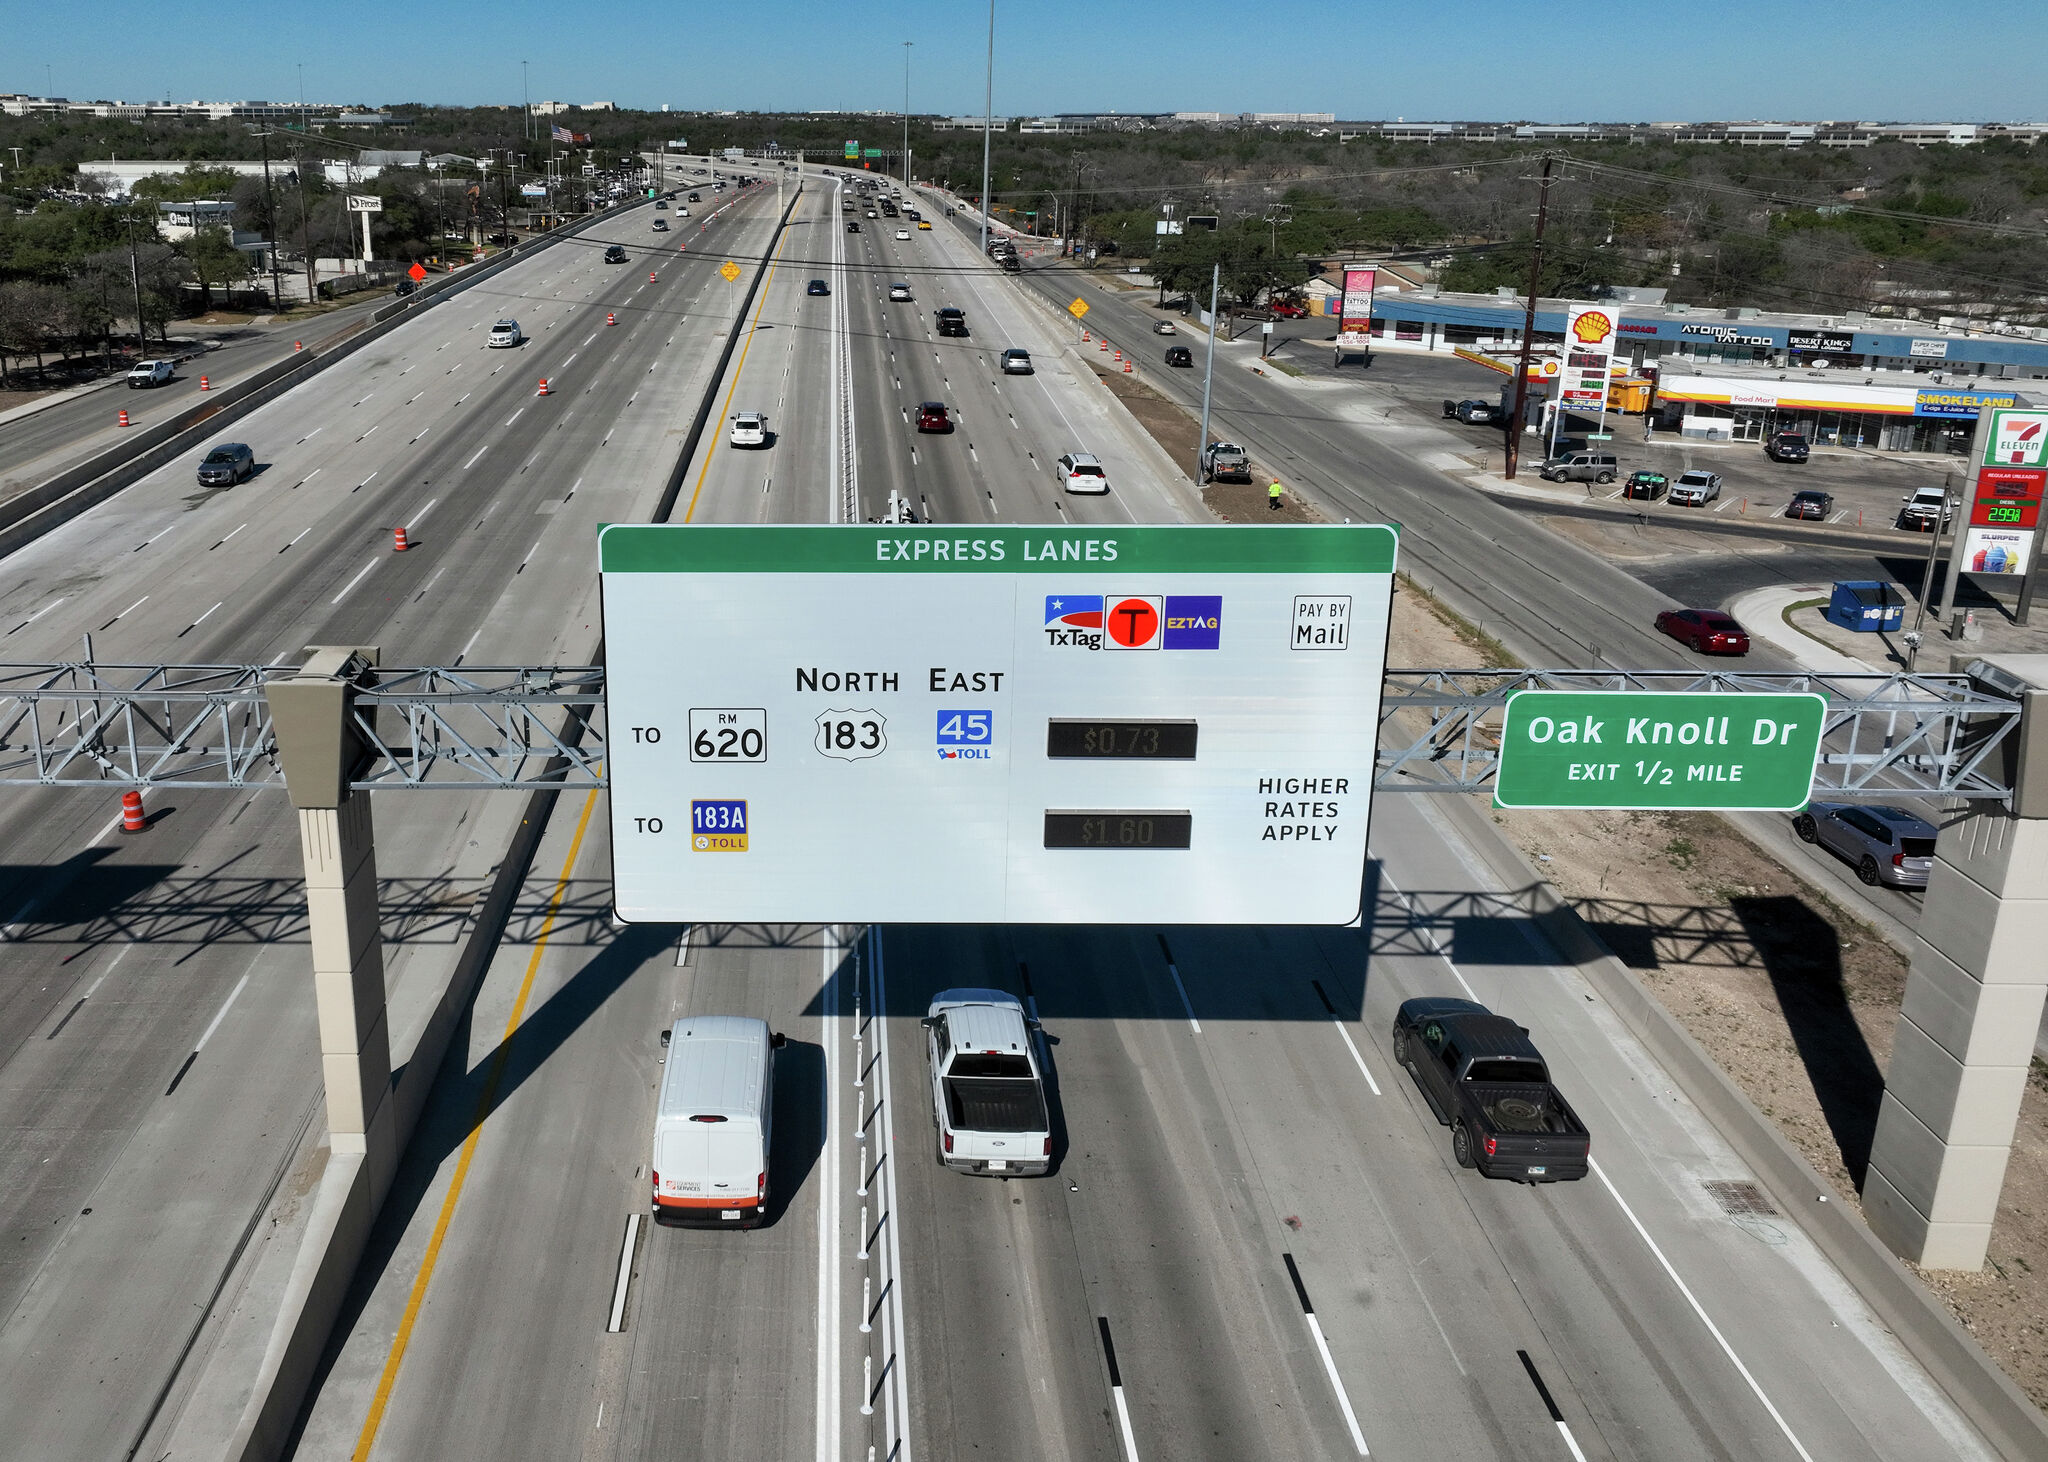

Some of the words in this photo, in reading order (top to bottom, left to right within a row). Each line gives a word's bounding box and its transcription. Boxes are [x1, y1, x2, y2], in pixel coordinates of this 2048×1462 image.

[360, 200, 379, 208] Frost
[1682, 325, 1738, 336] ATOMIC
[1715, 334, 1772, 346] TATTOO
[1790, 336, 1822, 346] DESERT
[1823, 339, 1851, 347] KINGS
[1917, 394, 2015, 408] SMOKELAND
[876, 540, 1006, 561] EXPRESS
[1023, 540, 1118, 562] LANES
[1299, 603, 1324, 617] PAY
[1329, 603, 1346, 617] BY
[1118, 608, 1149, 644] T
[1296, 624, 1344, 644] Mail
[1044, 628, 1102, 650] TxTag
[796, 668, 899, 692] NORTH
[930, 668, 1004, 692] EAST
[718, 714, 737, 724] RM
[822, 721, 880, 750] 183
[939, 714, 989, 741] 45
[1528, 715, 1605, 744] Oak
[1626, 716, 1729, 745] Knoll
[1752, 719, 1798, 745] Dr
[632, 728, 661, 744] TO
[694, 728, 763, 758] 620
[1084, 727, 1160, 754] $0.73
[957, 748, 991, 759] TOLL
[1568, 763, 1620, 781] EXIT
[1686, 765, 1743, 782] MILE
[1258, 778, 1349, 794] HIGHER
[694, 806, 745, 829] 183A
[1264, 802, 1339, 818] RATES
[635, 818, 663, 833] TO
[1082, 818, 1154, 846] $1.60
[1262, 826, 1338, 841] APPLY
[711, 838, 745, 848] TOLL
